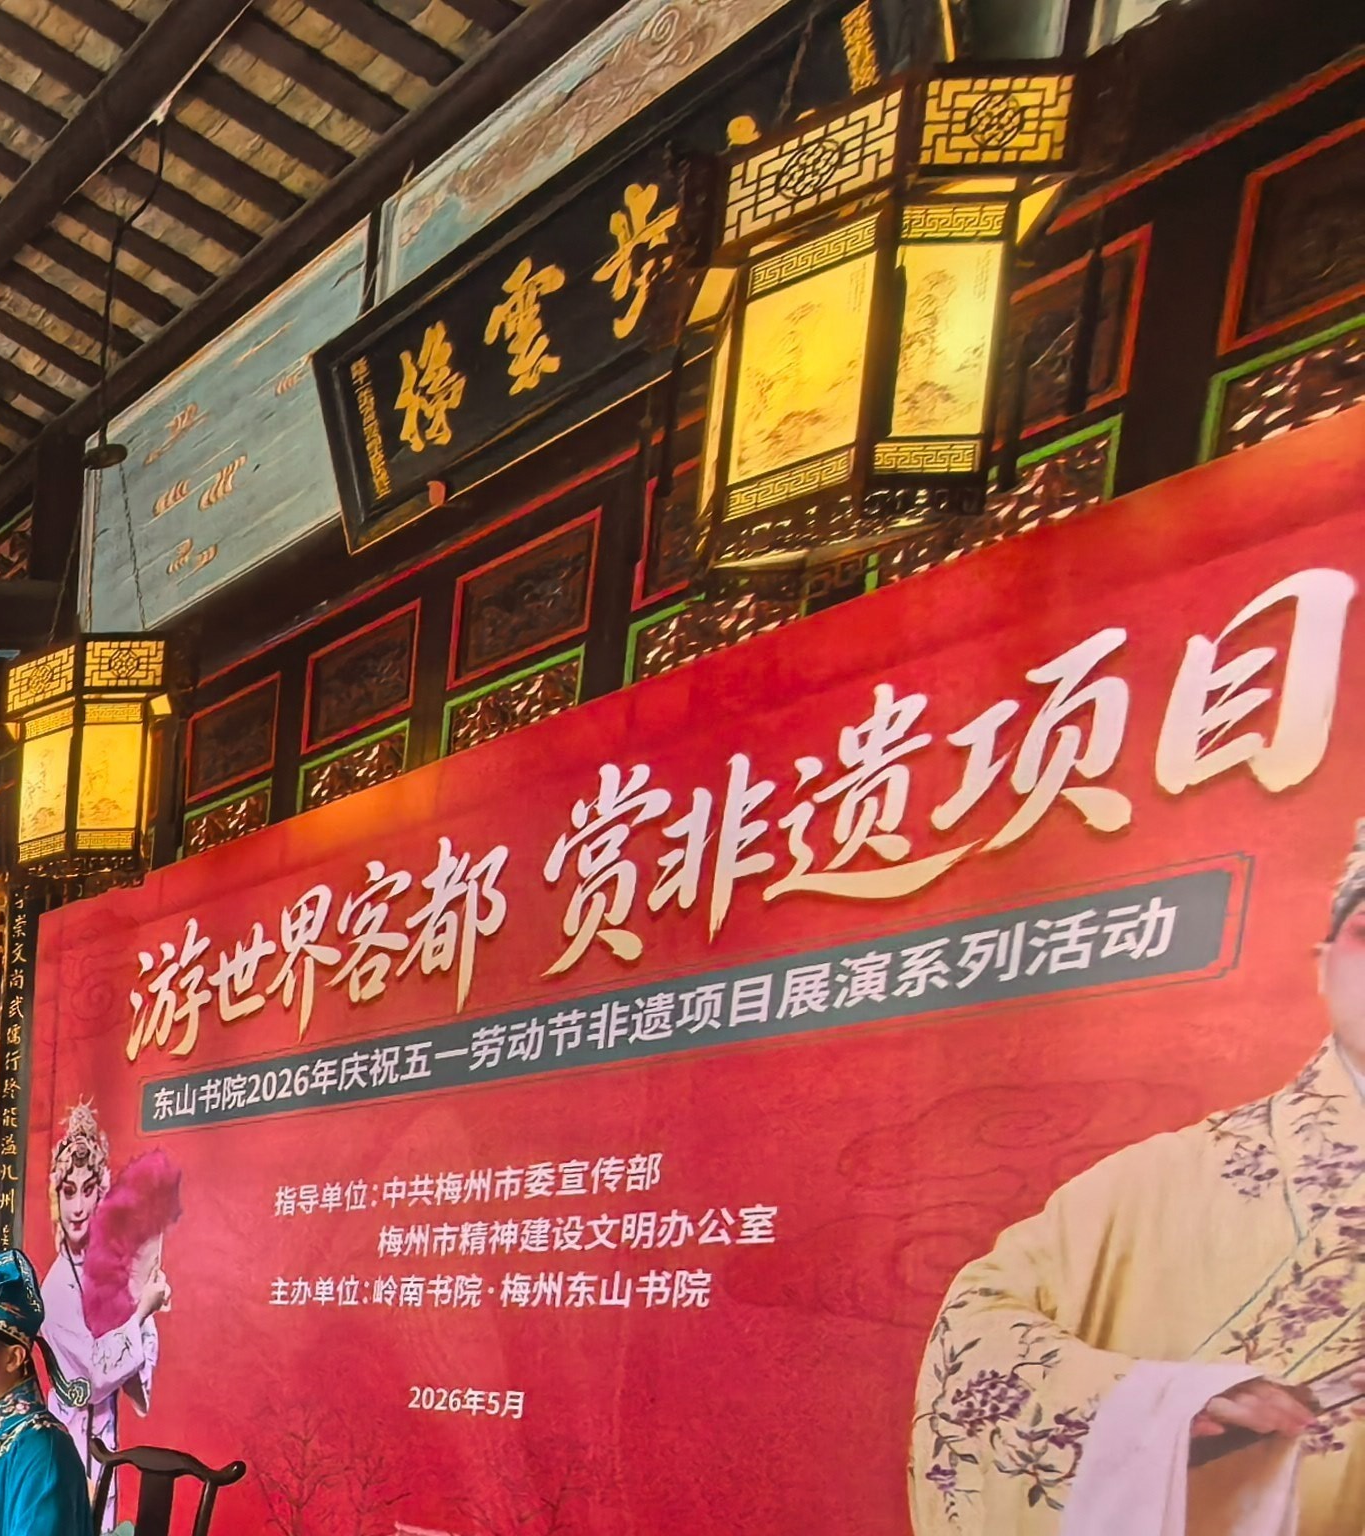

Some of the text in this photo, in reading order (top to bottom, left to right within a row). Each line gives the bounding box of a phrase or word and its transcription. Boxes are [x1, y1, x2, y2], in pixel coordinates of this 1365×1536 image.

[125, 567, 1357, 1061] 游世界客都 赏非遗项目
[153, 896, 1178, 1121] 东山书院2026年庆祝五一劳动节非遗项目展演系列活动
[274, 1153, 663, 1216] 指导单位:中共梅州市委宣传部
[377, 1203, 779, 1259] 梅州市精神建设文明办公室
[408, 1387, 526, 1419] 2026年5月
